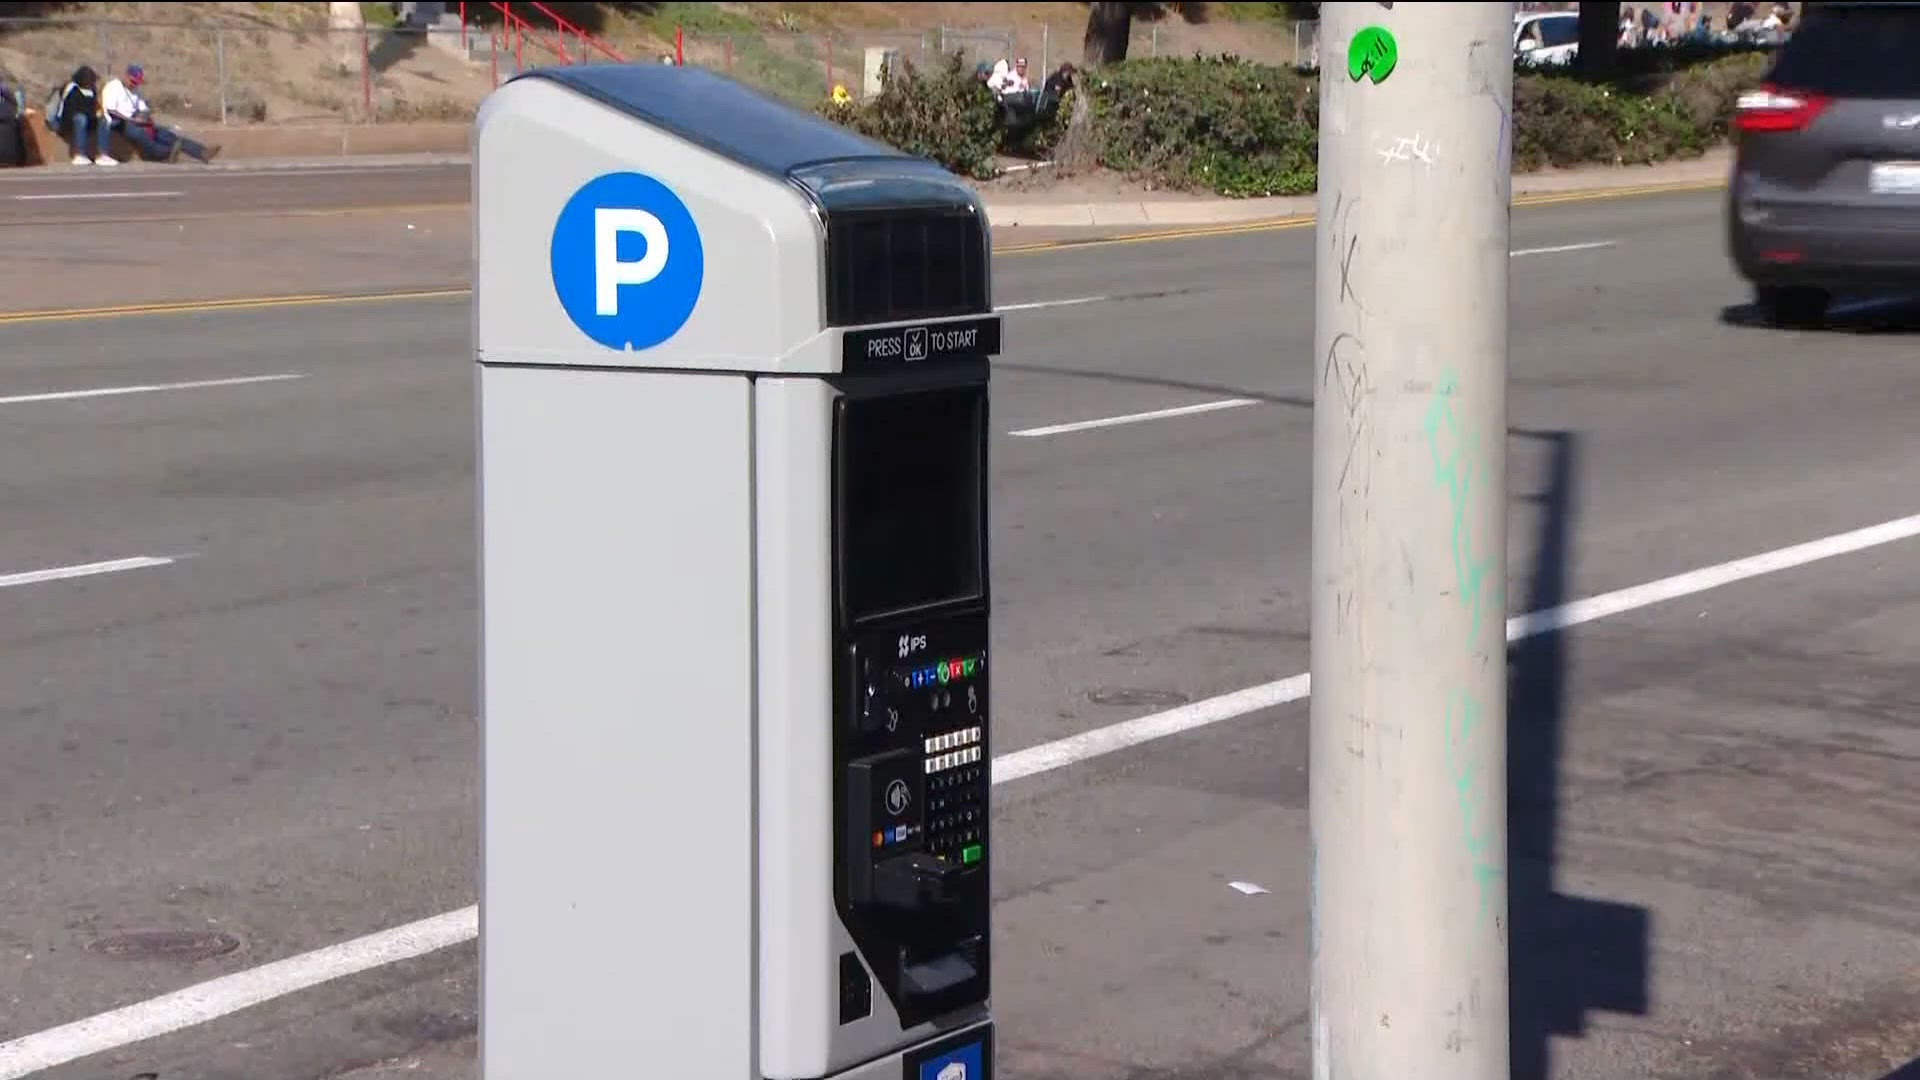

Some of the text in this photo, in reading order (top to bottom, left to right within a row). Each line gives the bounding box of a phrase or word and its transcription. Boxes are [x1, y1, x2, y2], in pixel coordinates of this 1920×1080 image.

[595, 207, 669, 316] P
[868, 329, 977, 358] PRESS OK TO START
[910, 635, 927, 651] IPS
